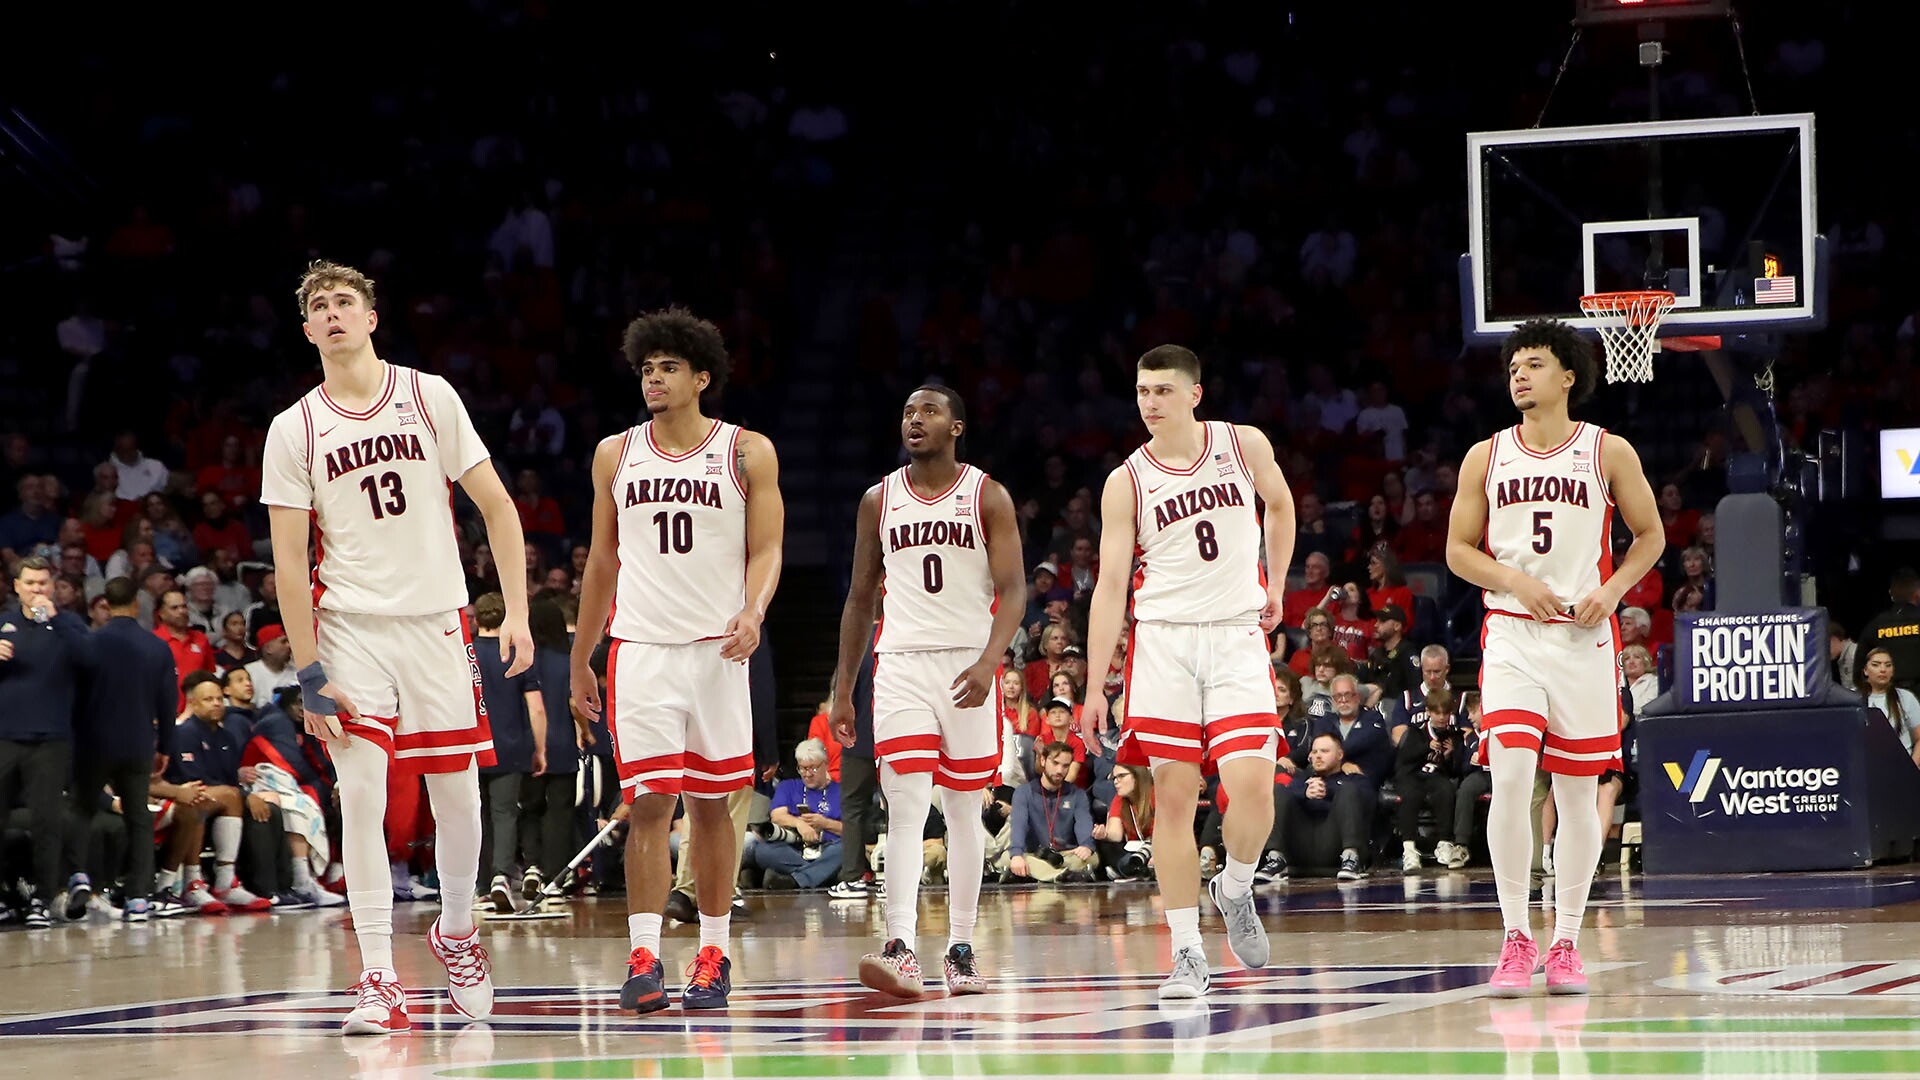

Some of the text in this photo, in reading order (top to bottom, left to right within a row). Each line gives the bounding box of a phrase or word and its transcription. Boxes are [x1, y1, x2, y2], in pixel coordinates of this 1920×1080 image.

[325, 434, 426, 482] ARIZONA
[360, 471, 406, 520] 13
[625, 478, 723, 509] ARIZONA
[1154, 482, 1244, 532] ARIZONA
[1497, 476, 1589, 509] ARIZONA
[652, 511, 693, 554] 10
[889, 520, 975, 553] ARIZONA
[1195, 520, 1219, 562] 8
[1532, 511, 1552, 555] 5
[923, 553, 943, 594] 0
[1698, 614, 1798, 627] SHAMROCK FARMS
[1878, 625, 1919, 638] POLICE
[1692, 624, 1810, 667] ROCKIN'
[1693, 664, 1805, 702] PROTEIN
[1721, 766, 1840, 791] Vantage
[1719, 792, 1791, 815] West
[1792, 794, 1840, 804] CREDIT
[1796, 803, 1838, 812] UNION
